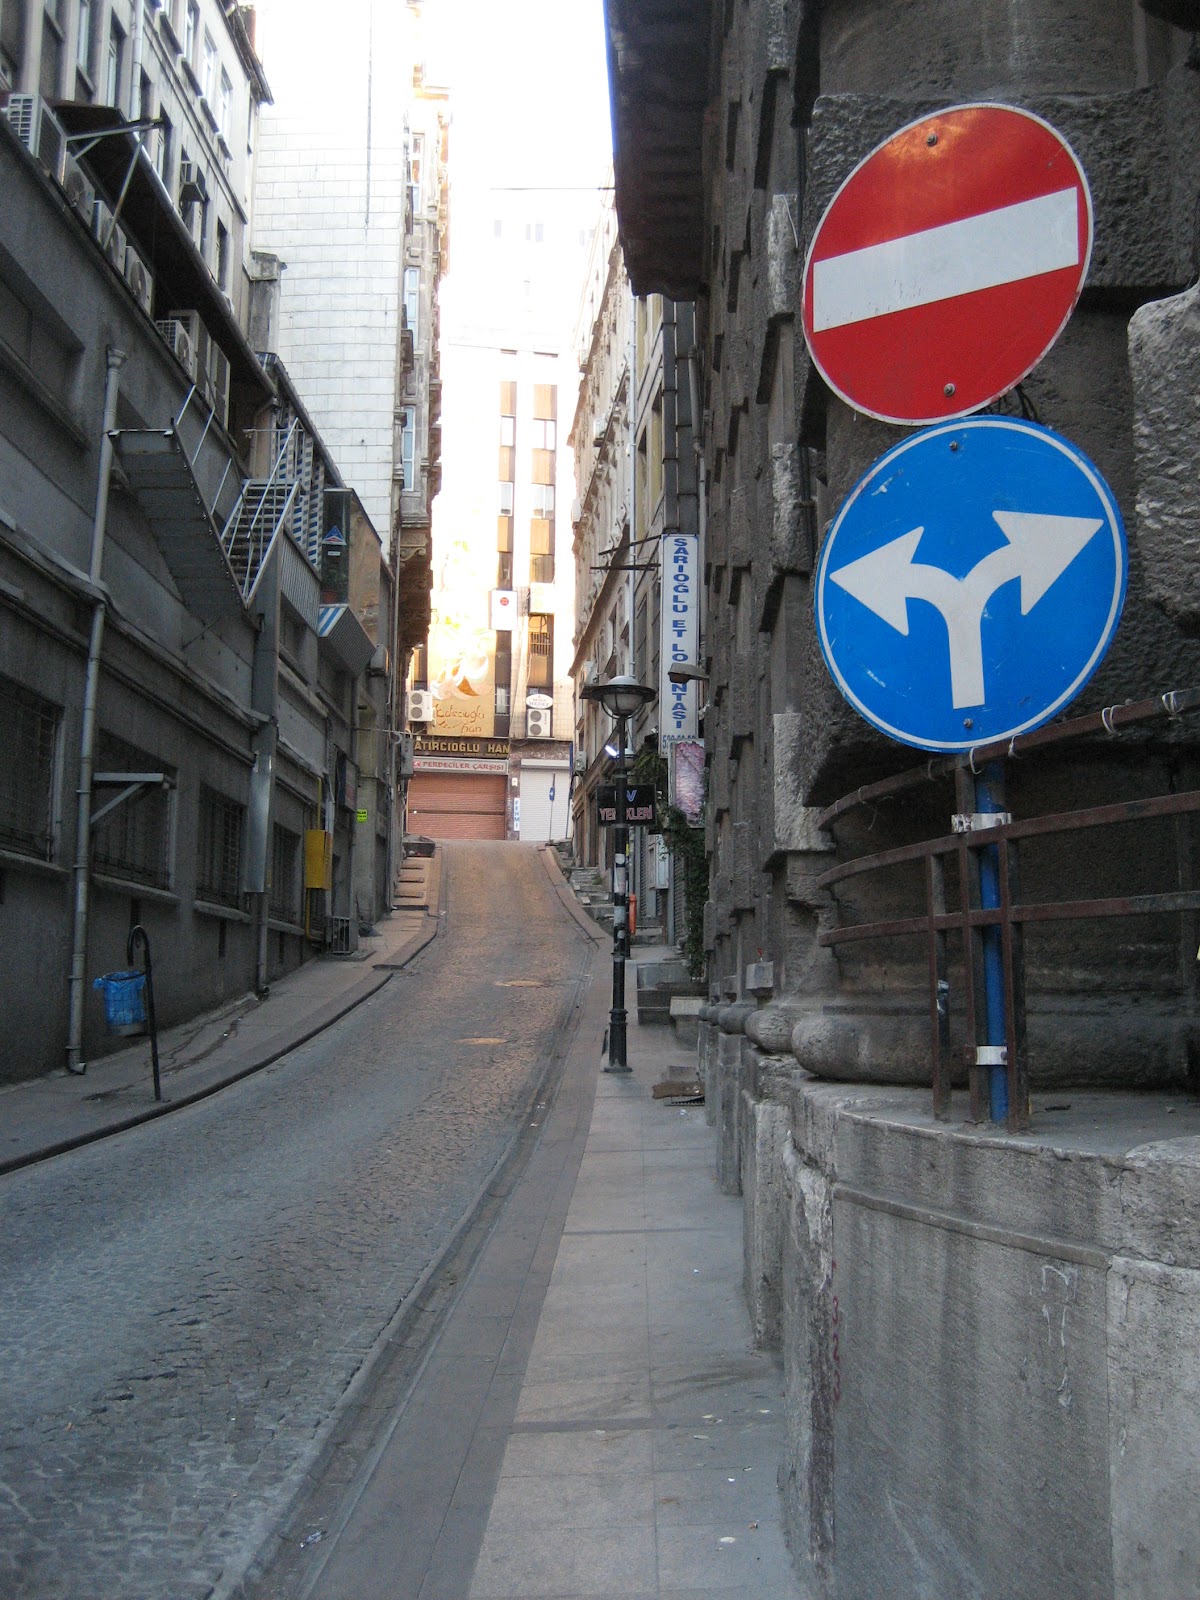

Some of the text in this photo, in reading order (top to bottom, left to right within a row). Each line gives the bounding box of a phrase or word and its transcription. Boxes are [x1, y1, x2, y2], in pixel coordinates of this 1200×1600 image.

[673, 538, 689, 612] SARIOĞLU
[672, 619, 687, 637] ET
[671, 643, 689, 729] LONTASI
[414, 740, 510, 754] ATIRCIOĞLU HAN
